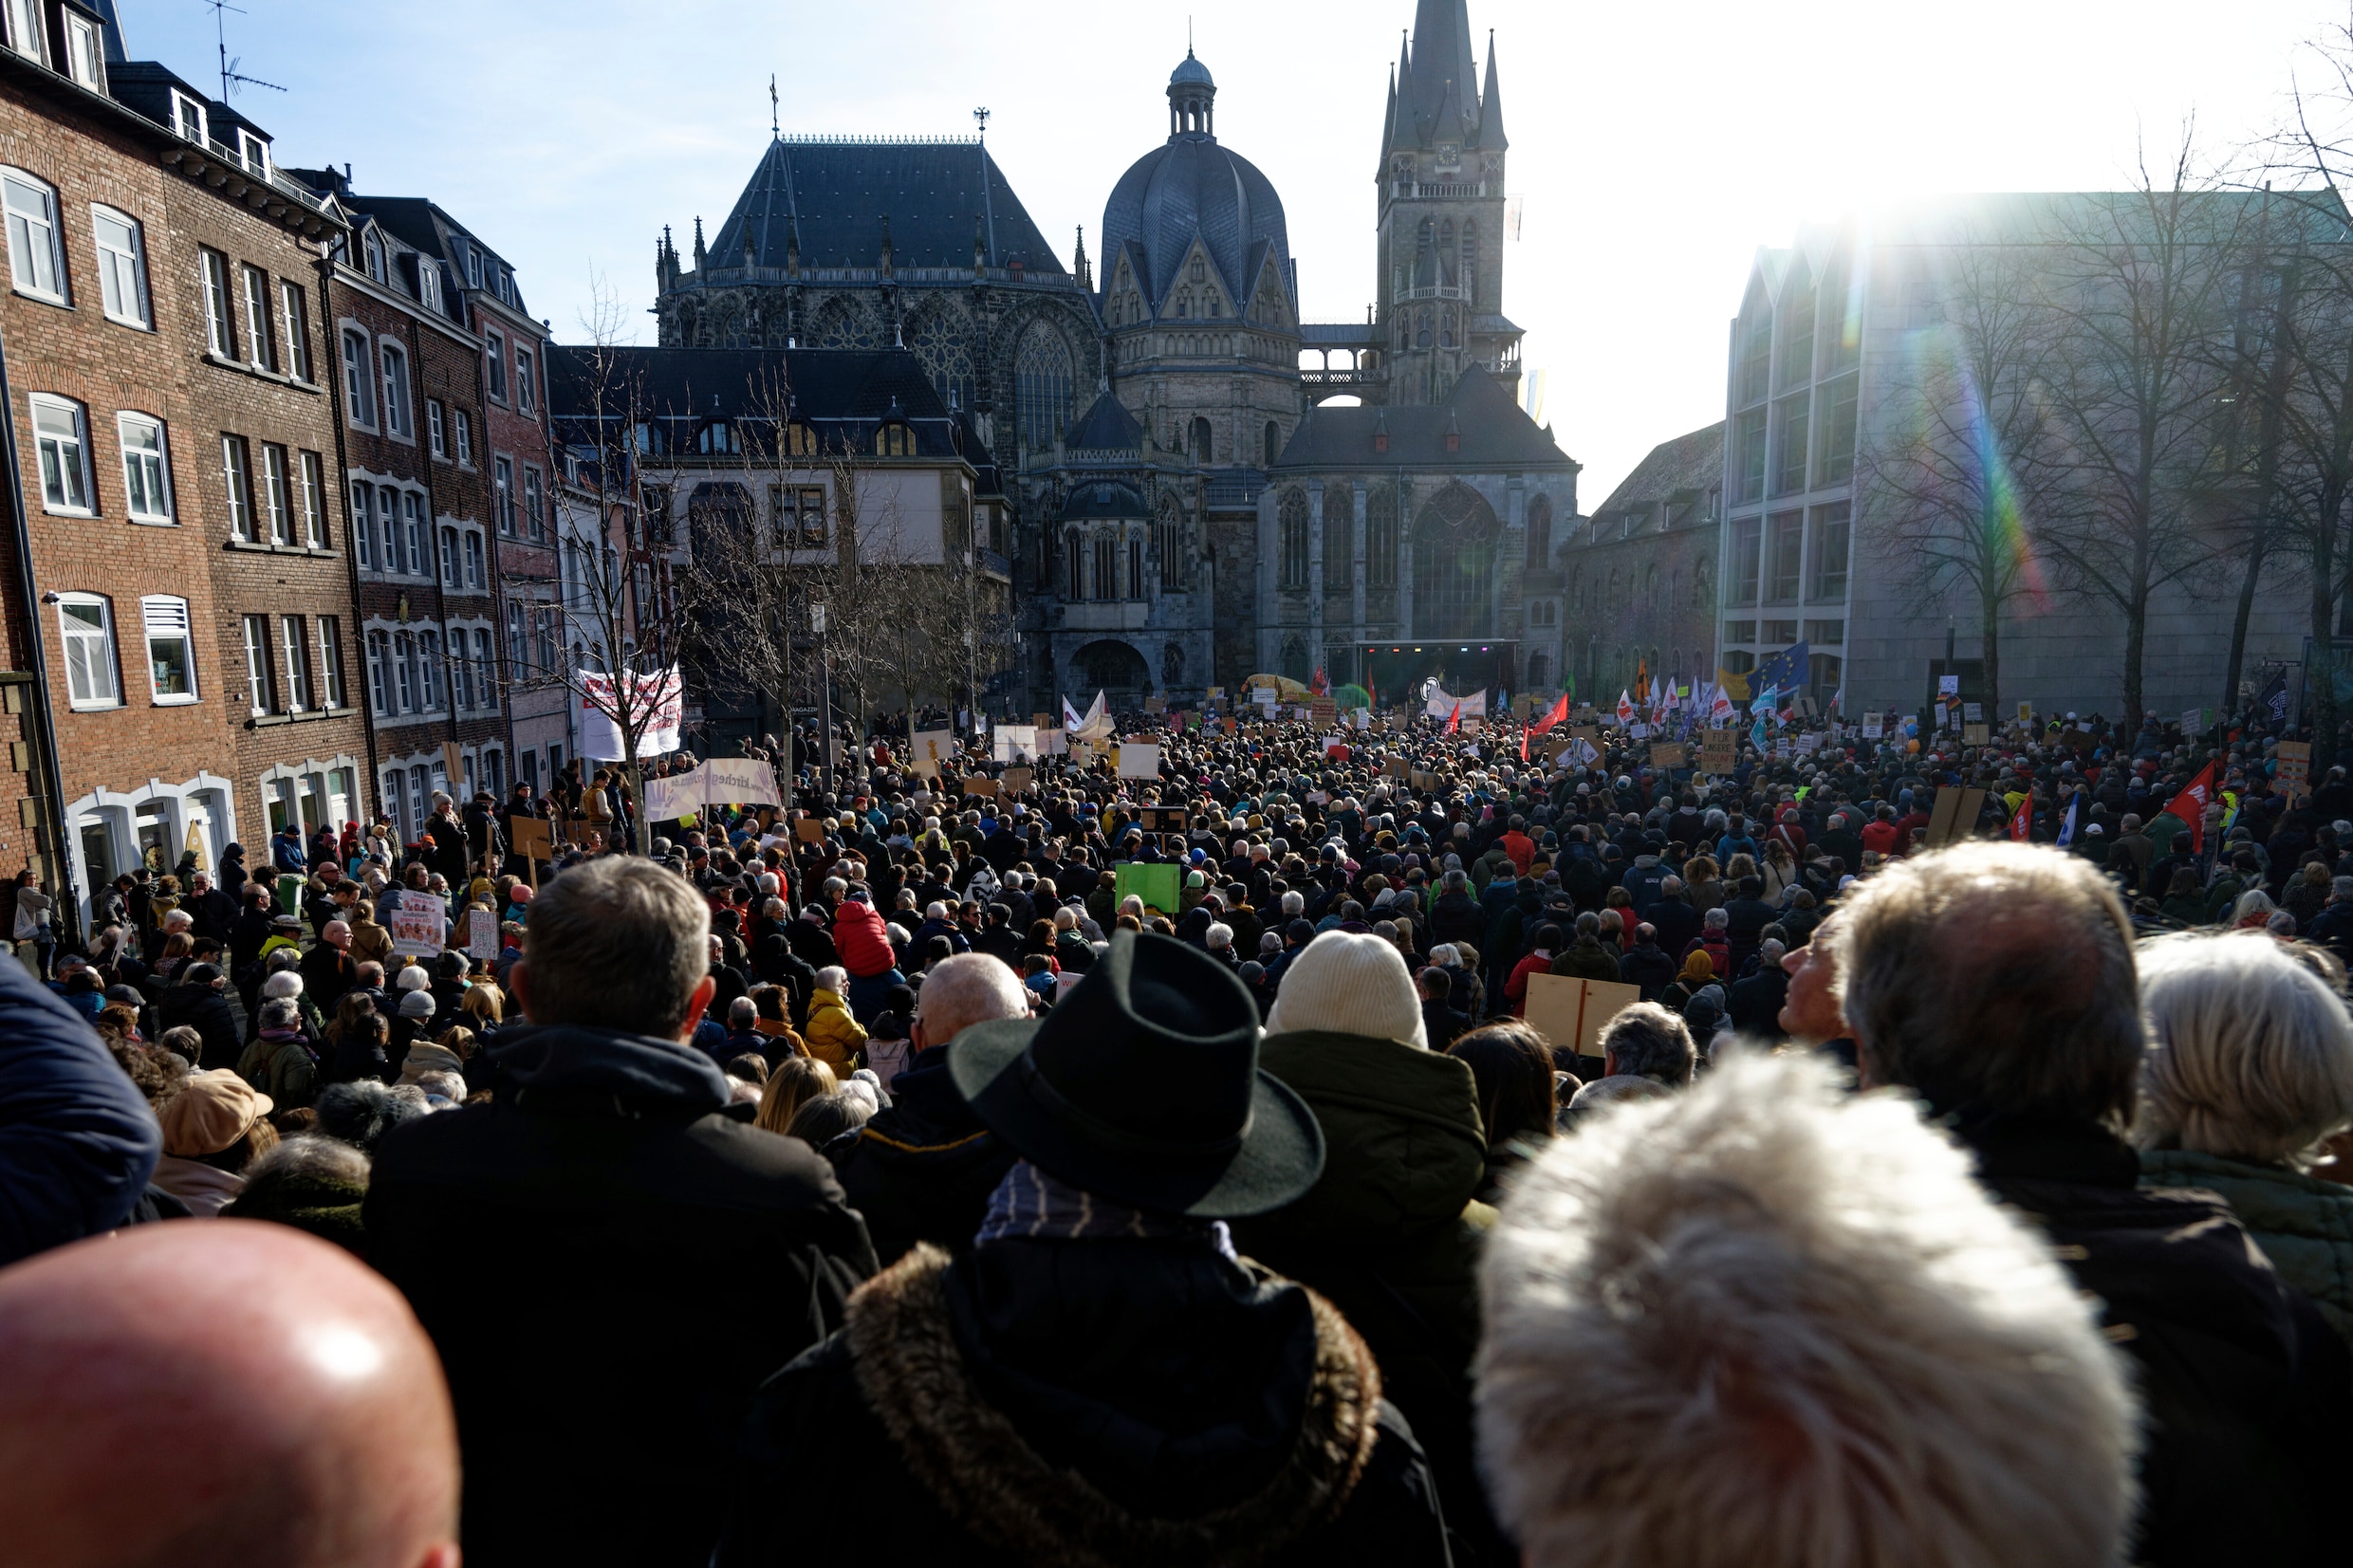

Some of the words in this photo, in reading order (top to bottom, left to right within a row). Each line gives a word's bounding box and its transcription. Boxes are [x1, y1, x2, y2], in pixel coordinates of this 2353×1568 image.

[1713, 732, 1730, 742] FÜR
[1704, 744, 1731, 752] UNSERE
[1702, 754, 1733, 763] ZUKUNFT
[471, 913, 495, 922] RESPEKT
[471, 922, 496, 931] TOLERANZ
